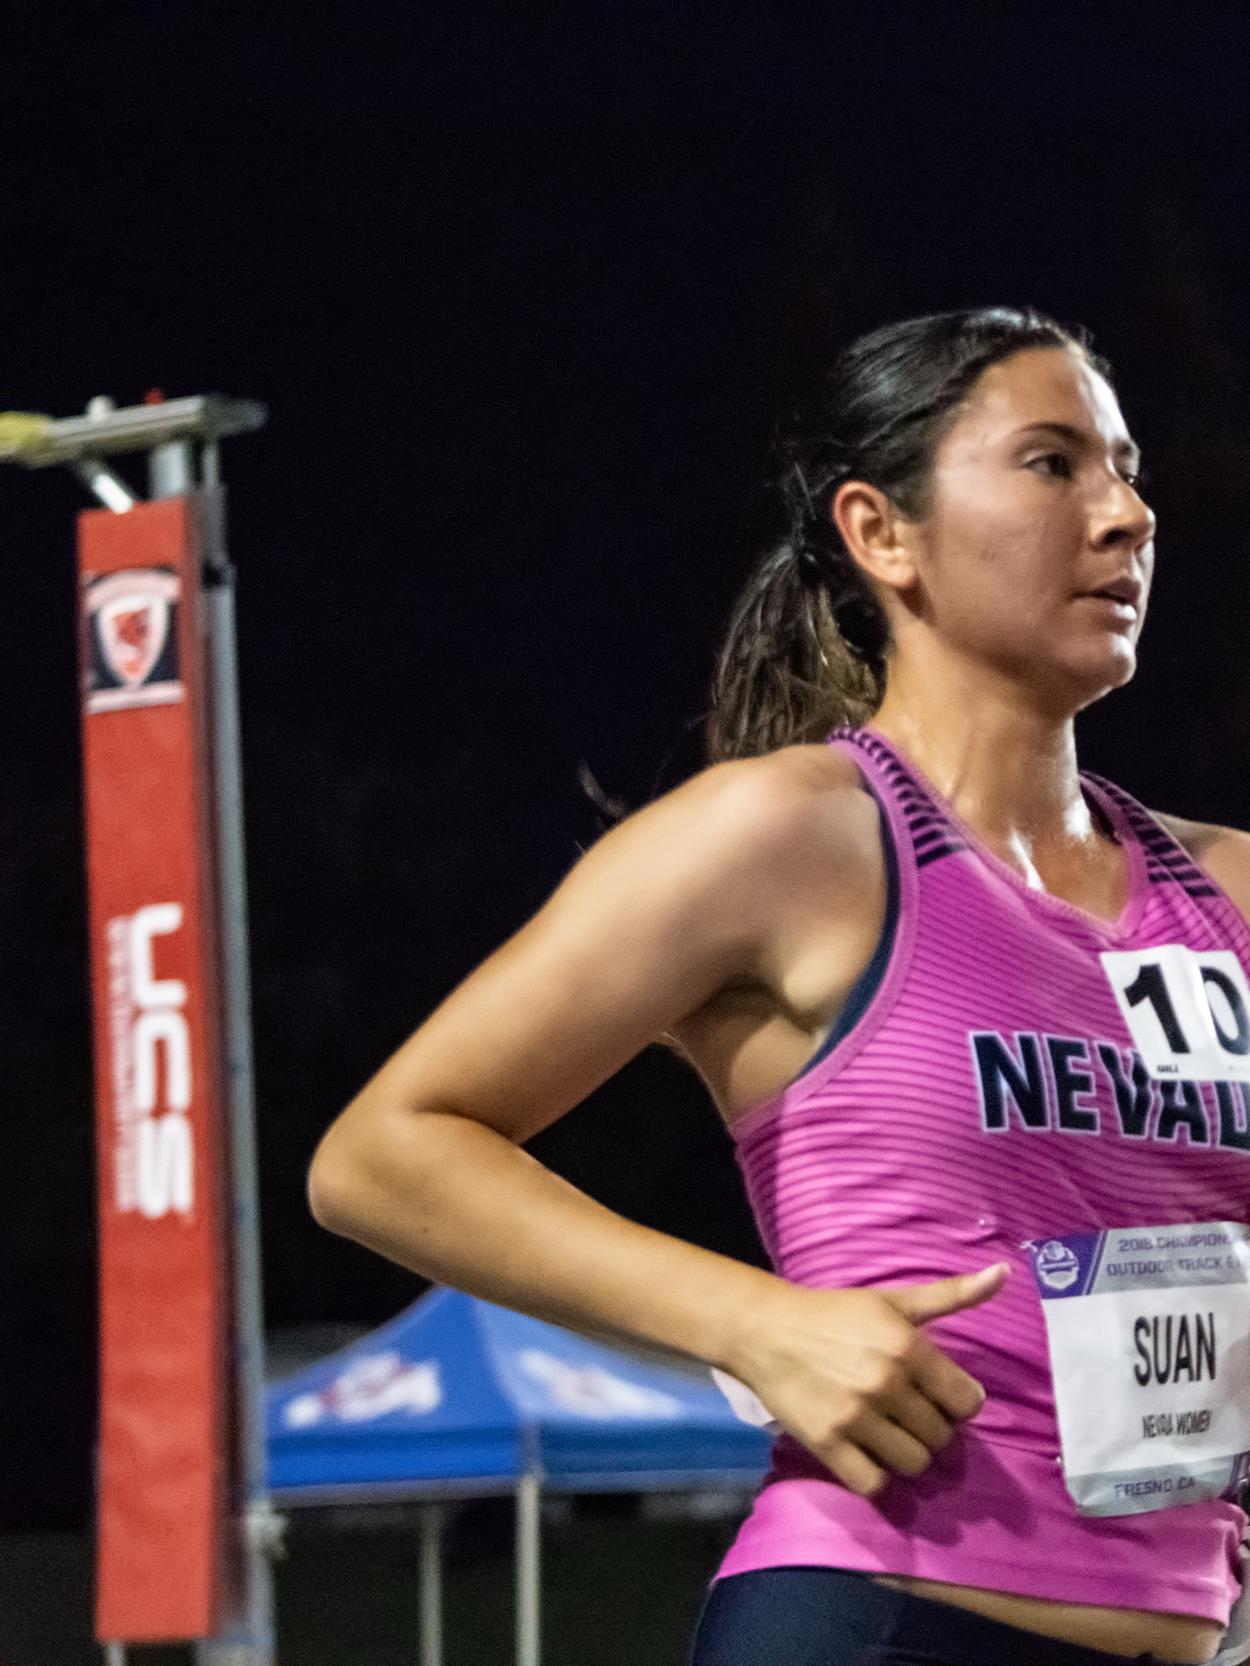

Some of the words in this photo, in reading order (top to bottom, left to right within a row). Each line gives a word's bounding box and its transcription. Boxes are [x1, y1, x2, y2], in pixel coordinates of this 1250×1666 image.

[130, 902, 194, 1219] UCS
[1178, 1256, 1223, 1271] TRACK
[1133, 1312, 1217, 1386] SUAN
[1177, 1476, 1196, 1490] CA
